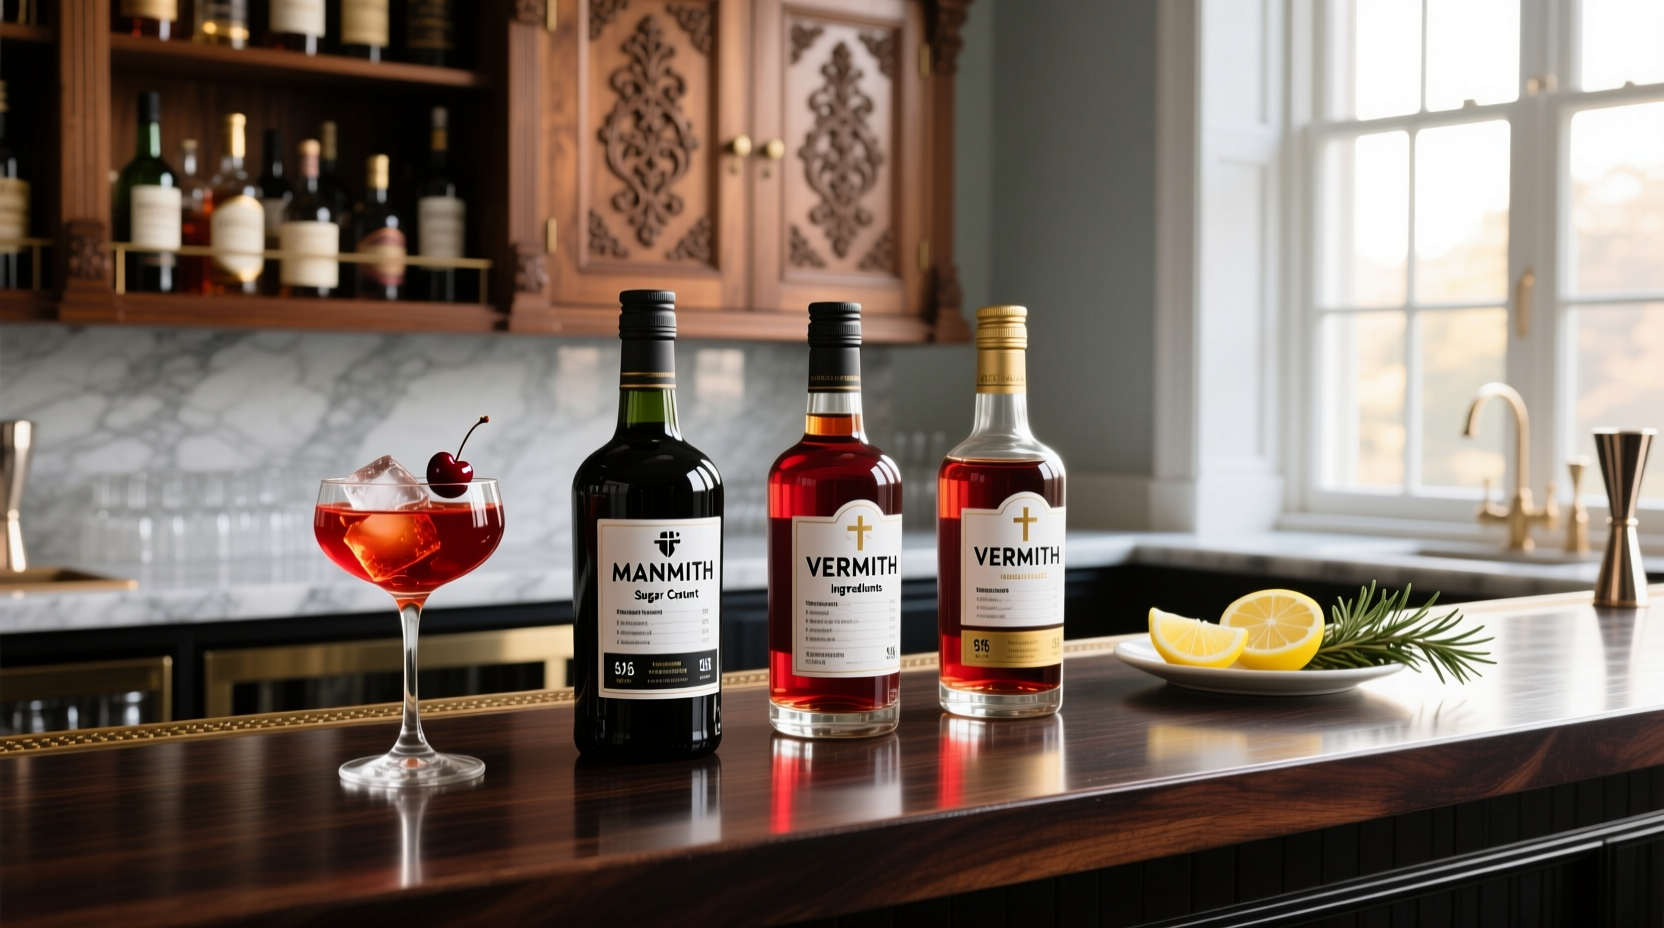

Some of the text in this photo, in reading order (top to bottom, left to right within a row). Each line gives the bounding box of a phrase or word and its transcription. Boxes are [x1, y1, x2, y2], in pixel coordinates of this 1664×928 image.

[805, 555, 897, 578] VERMITH
[973, 546, 1060, 567] VERMITH
[612, 560, 713, 583] MANMITH
[634, 588, 665, 604] Sugar
